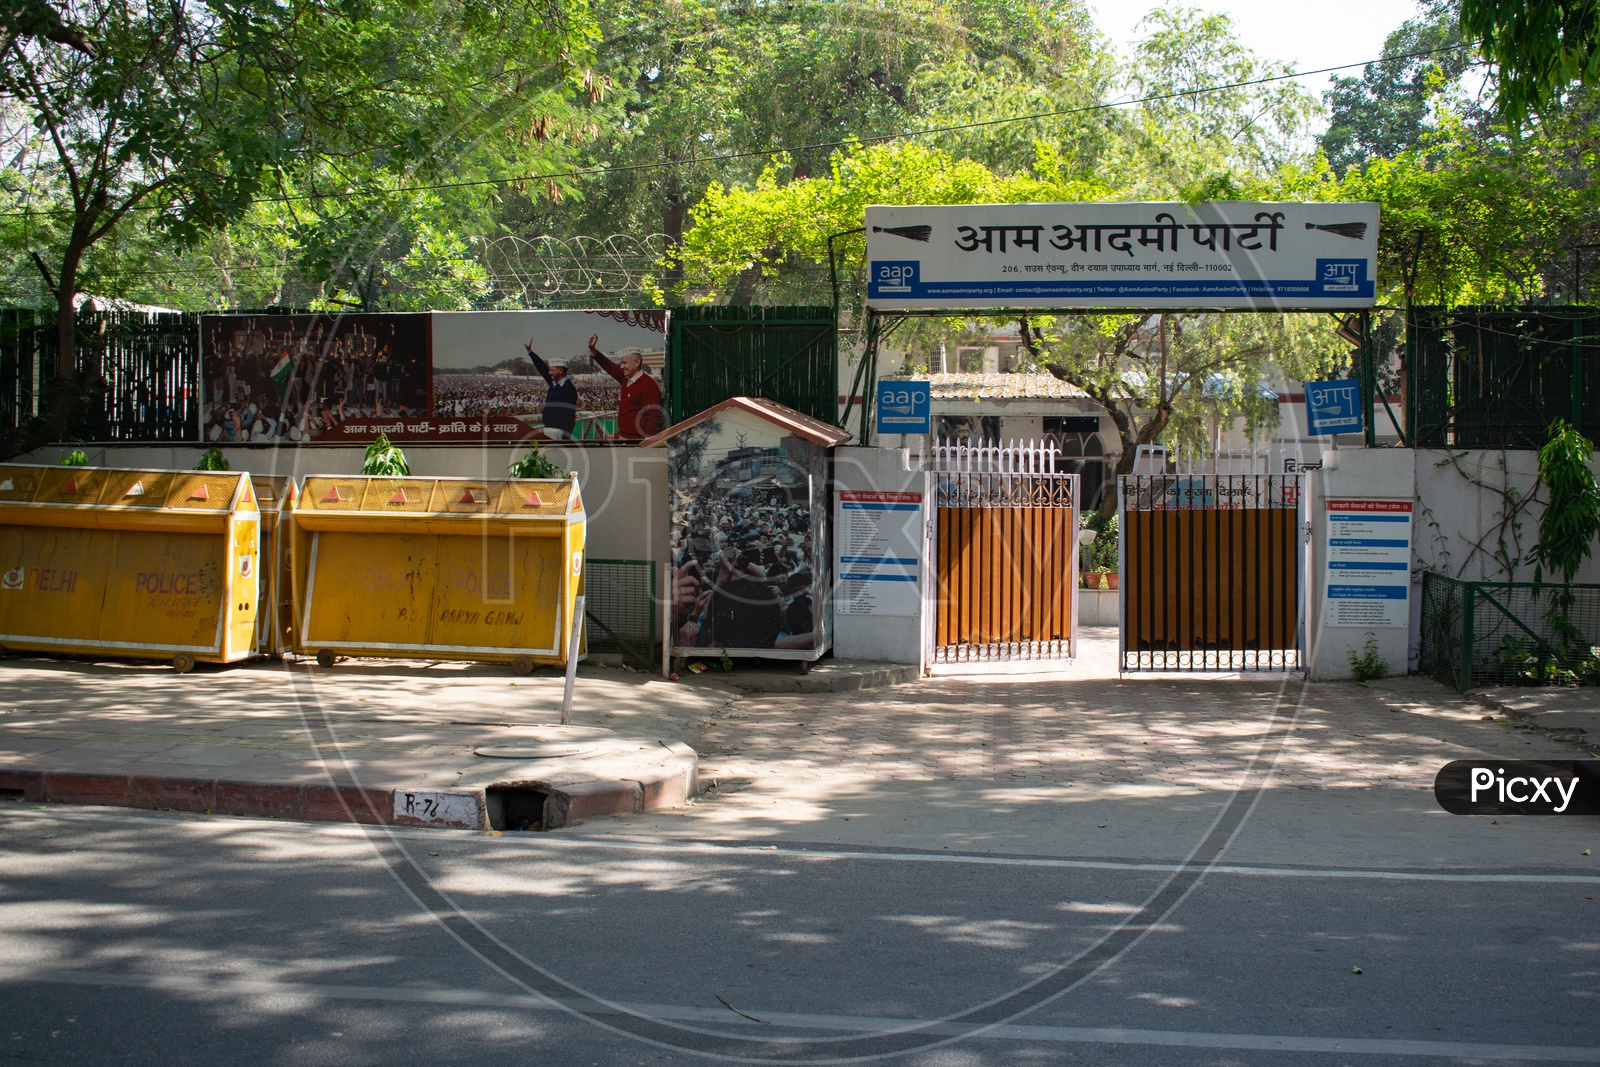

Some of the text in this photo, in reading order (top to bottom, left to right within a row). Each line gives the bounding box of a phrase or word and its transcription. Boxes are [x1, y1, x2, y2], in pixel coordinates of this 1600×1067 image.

[954, 212, 1286, 257] आम आदमी पार्टी
[880, 266, 914, 286] aap
[1002, 266, 1022, 274] 206,
[1024, 264, 1044, 272] राउस
[1071, 262, 1084, 272] दीन
[1143, 262, 1160, 272] मार्ग,
[1163, 262, 1174, 272] नई
[1324, 264, 1360, 286] आप
[882, 391, 926, 414] aap
[1312, 387, 1355, 415] आप
[343, 425, 367, 434] आम
[370, 422, 404, 434] आदमी
[439, 422, 467, 434] क्रांति
[469, 422, 481, 432] के
[484, 424, 490, 433] 6
[493, 423, 518, 433] साल
[28, 568, 197, 594] DELHI POLICE
[456, 572, 514, 596] POLICE
[484, 610, 524, 626] GANJ
